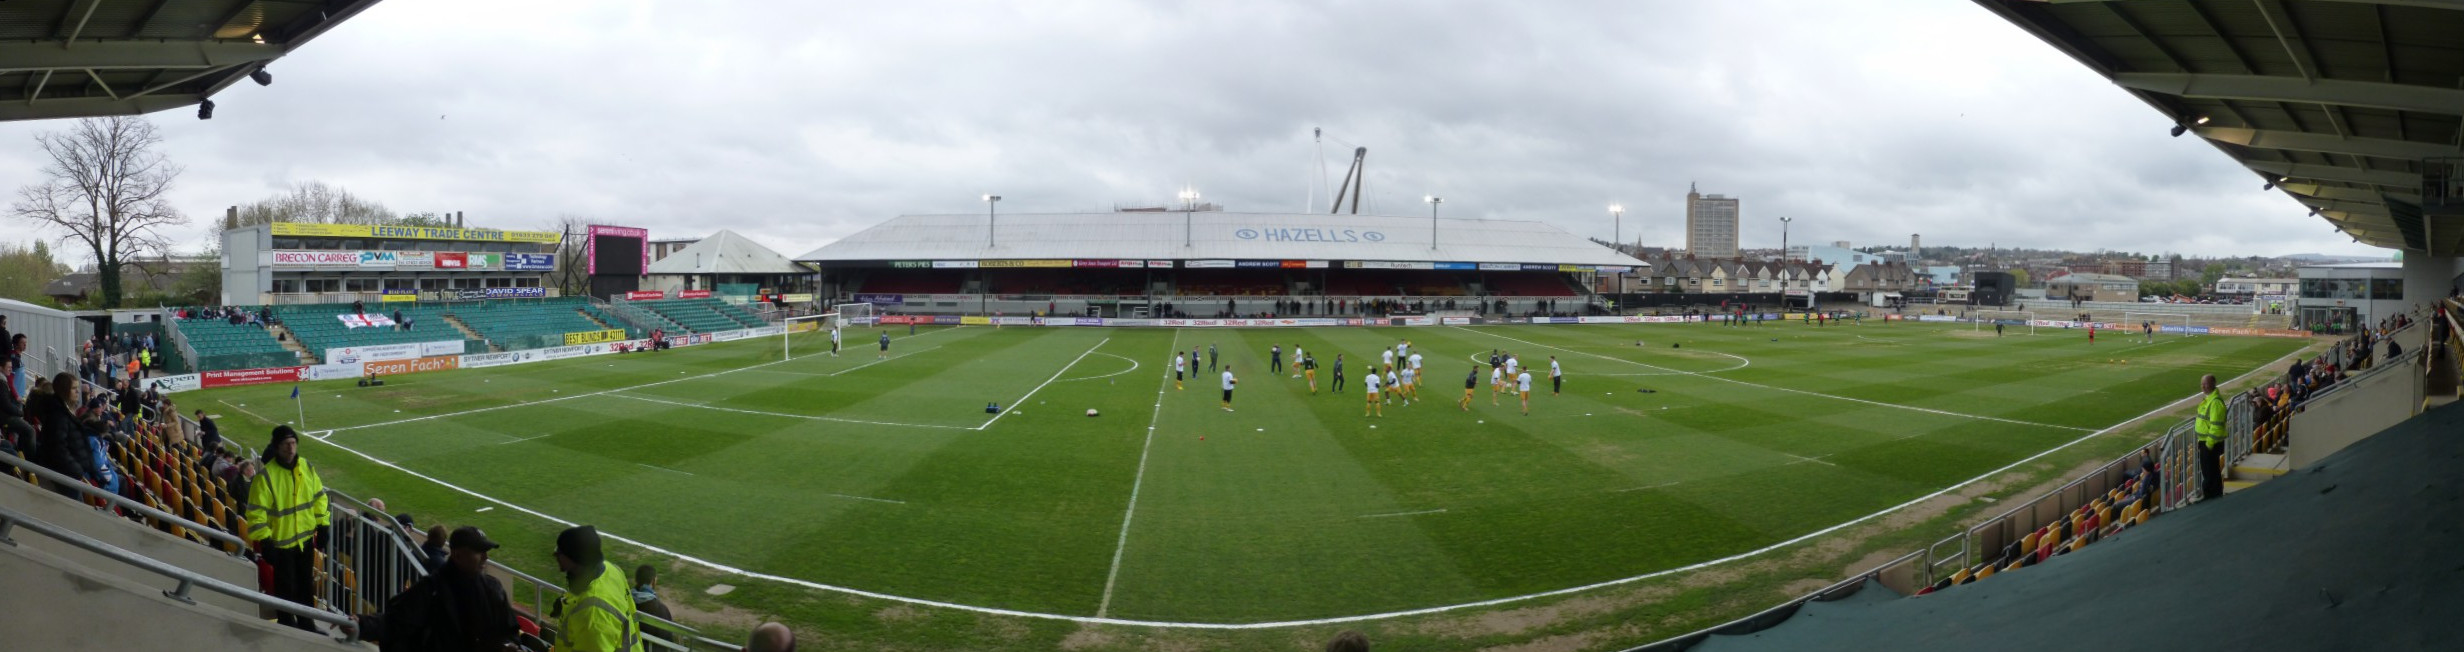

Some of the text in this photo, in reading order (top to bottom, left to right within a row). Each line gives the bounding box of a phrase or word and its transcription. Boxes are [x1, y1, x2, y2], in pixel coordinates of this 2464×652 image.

[371, 226, 504, 240] LEEWAY TRADE CENTRE
[1264, 228, 1358, 242] HAZELLS
[275, 251, 357, 263] BRECON CARREG
[469, 254, 487, 267] RMS
[565, 333, 579, 344] BEST
[581, 331, 600, 343] BLINDS
[365, 363, 406, 375] Seren
[410, 358, 440, 371] Fach
